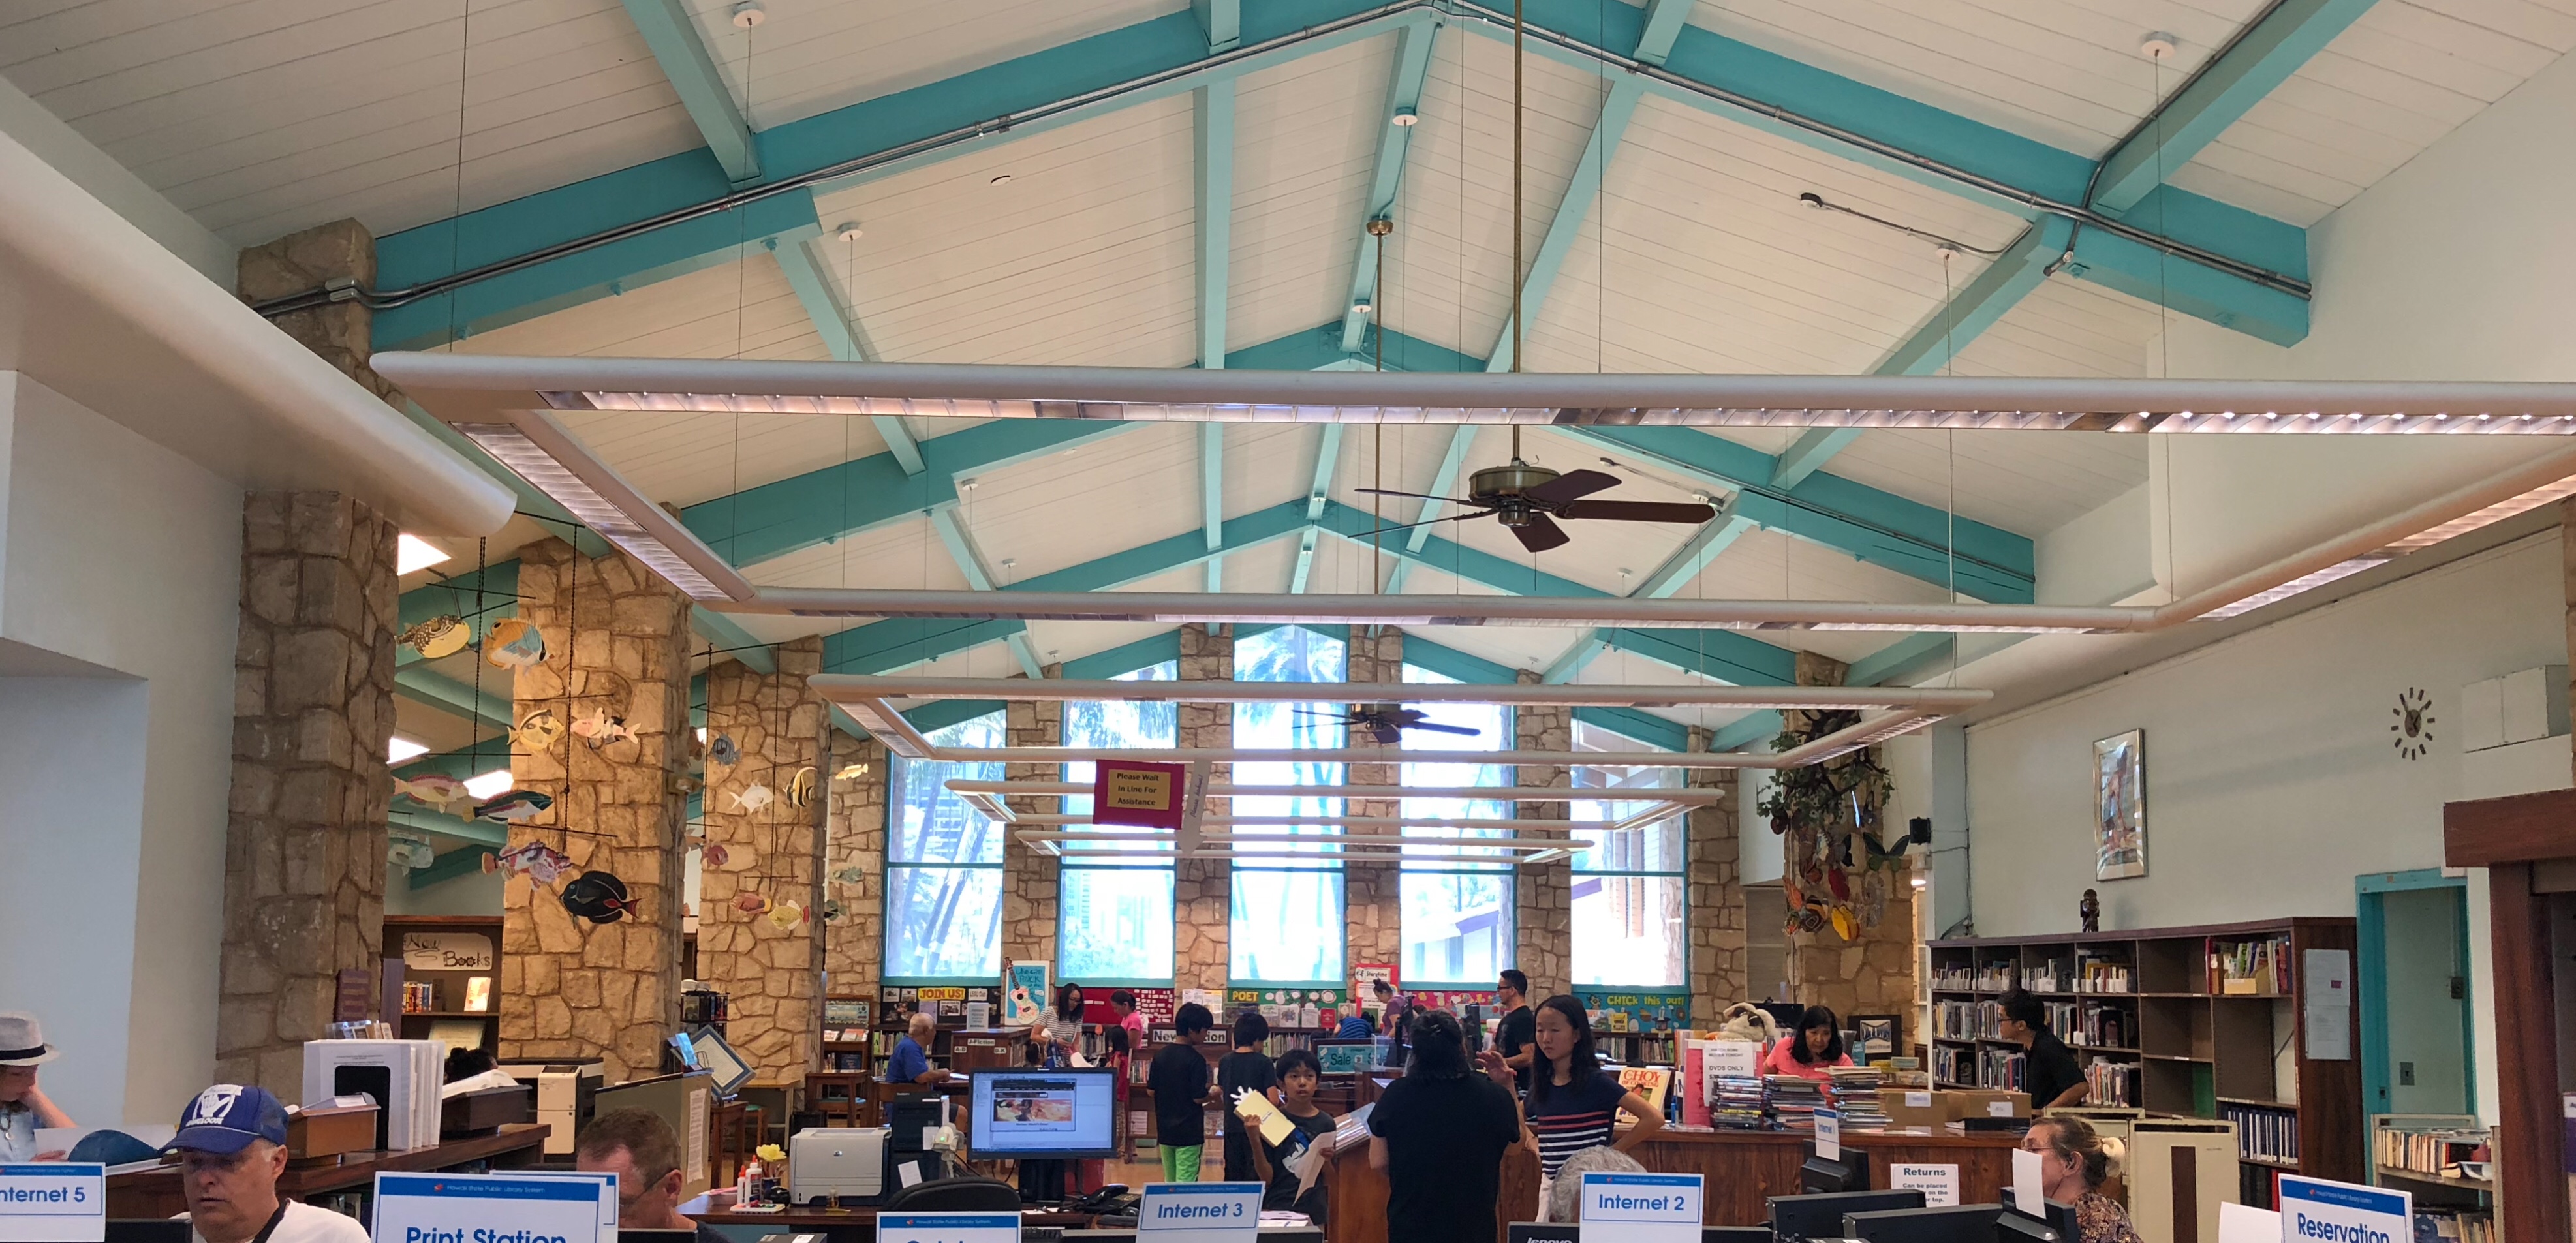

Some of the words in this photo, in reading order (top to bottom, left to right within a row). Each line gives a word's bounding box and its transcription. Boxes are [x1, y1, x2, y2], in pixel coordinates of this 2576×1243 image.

[1117, 773, 1141, 781] Please
[1142, 773, 1159, 782] Wait
[1117, 797, 1156, 806] Assistance
[442, 951, 491, 967] Books
[920, 989, 946, 999] JOIN
[948, 989, 965, 999] US!
[1232, 991, 1259, 1002] POET
[1643, 996, 1660, 1005] this
[1666, 996, 1684, 1005] out!
[1331, 1053, 1351, 1066] Sale
[1624, 1070, 1661, 1082] CHOY
[1903, 1167, 1946, 1176] Returns
[0, 1187, 68, 1202] nternet
[74, 1187, 85, 1202] 5
[1598, 1194, 1668, 1210] Internet
[1674, 1196, 1684, 1211] 2
[1158, 1203, 1228, 1218] Internet
[1232, 1203, 1243, 1217] 3
[2297, 1212, 2390, 1243] Reservation
[406, 1227, 464, 1243] Print
[473, 1228, 566, 1243] Station
